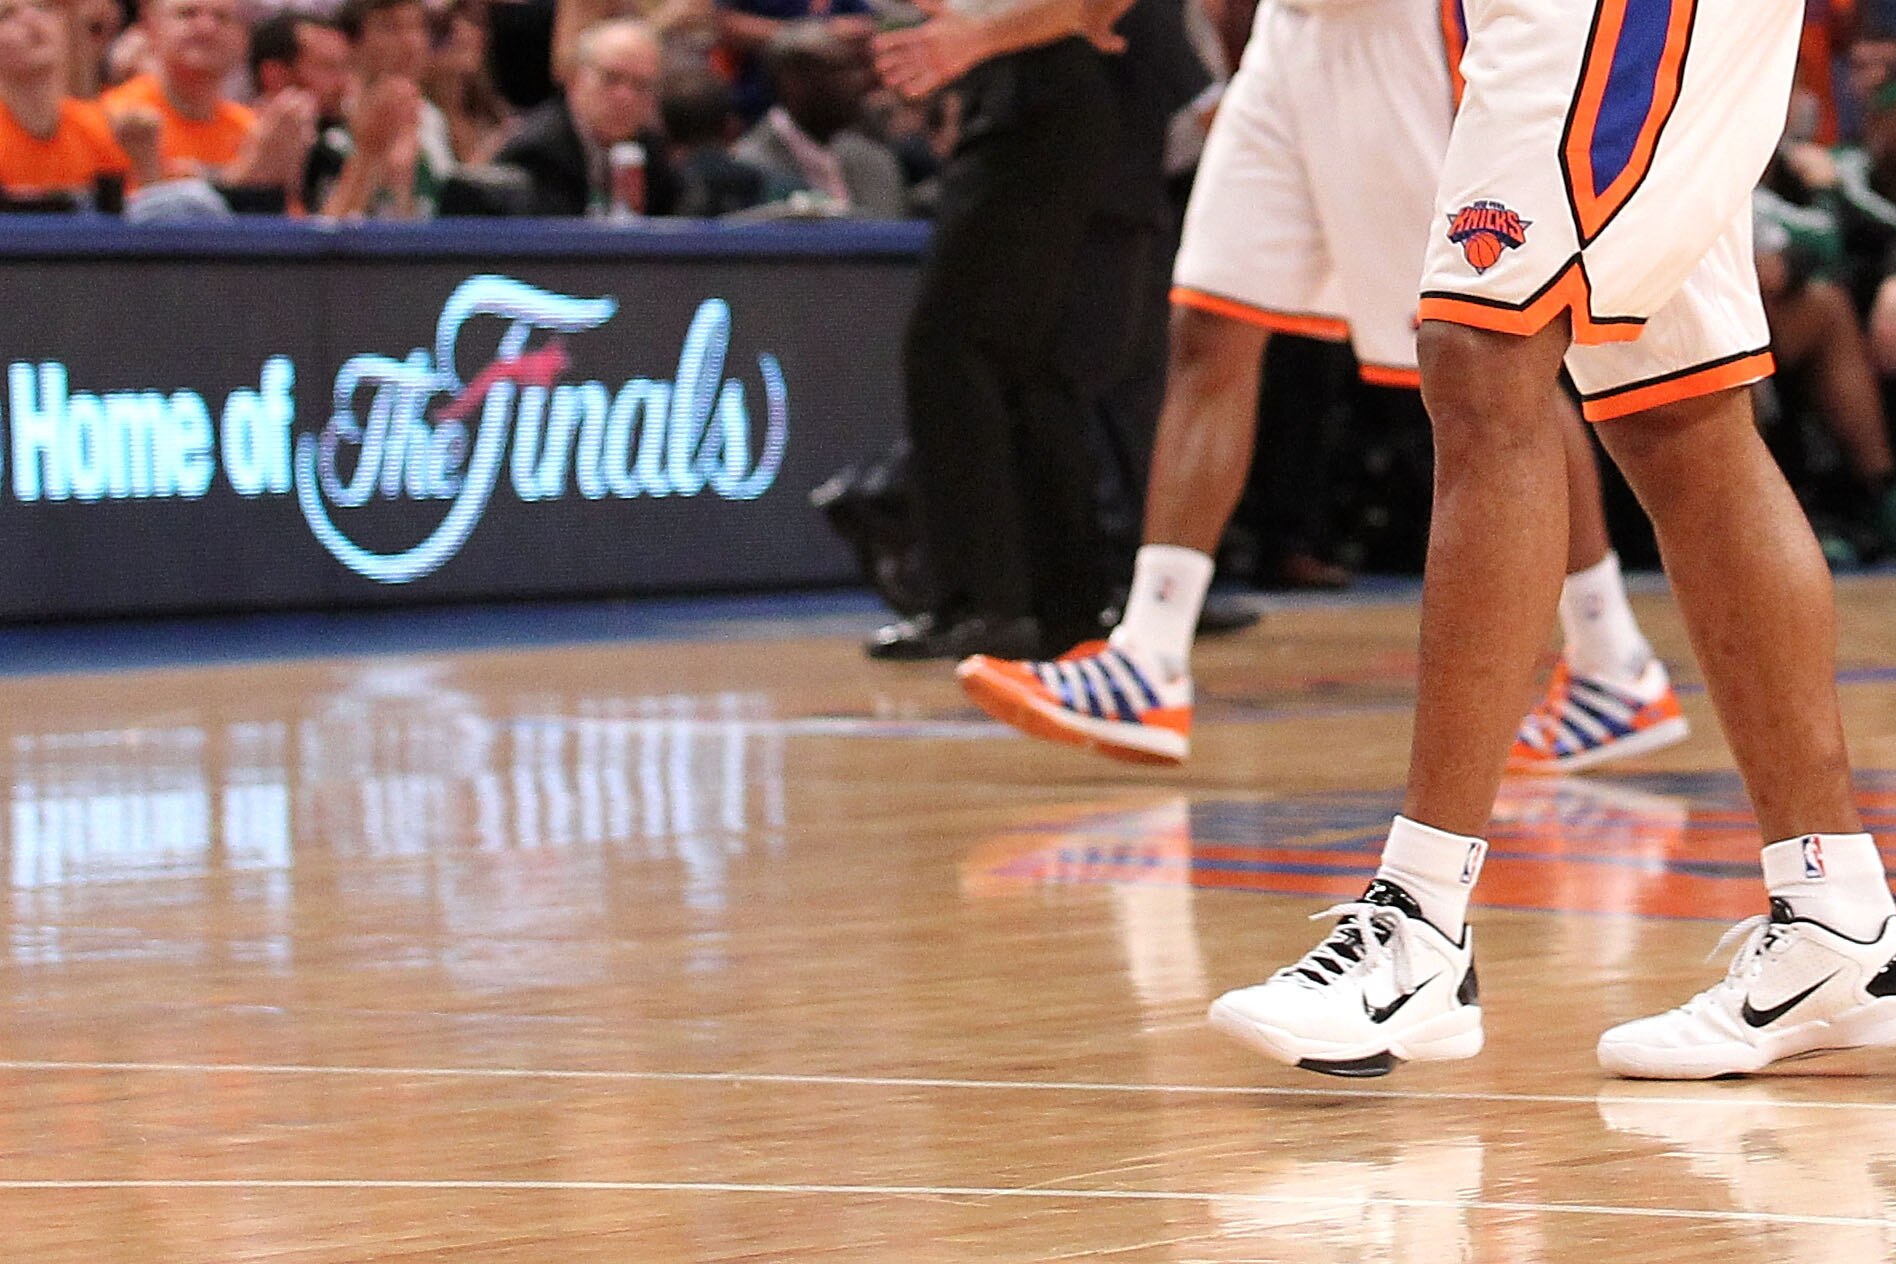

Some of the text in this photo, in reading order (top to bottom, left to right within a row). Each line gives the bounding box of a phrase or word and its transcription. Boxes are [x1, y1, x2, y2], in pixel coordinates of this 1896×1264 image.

[1446, 206, 1527, 244] KNICKS
[7, 274, 788, 585] Home of The Finals
